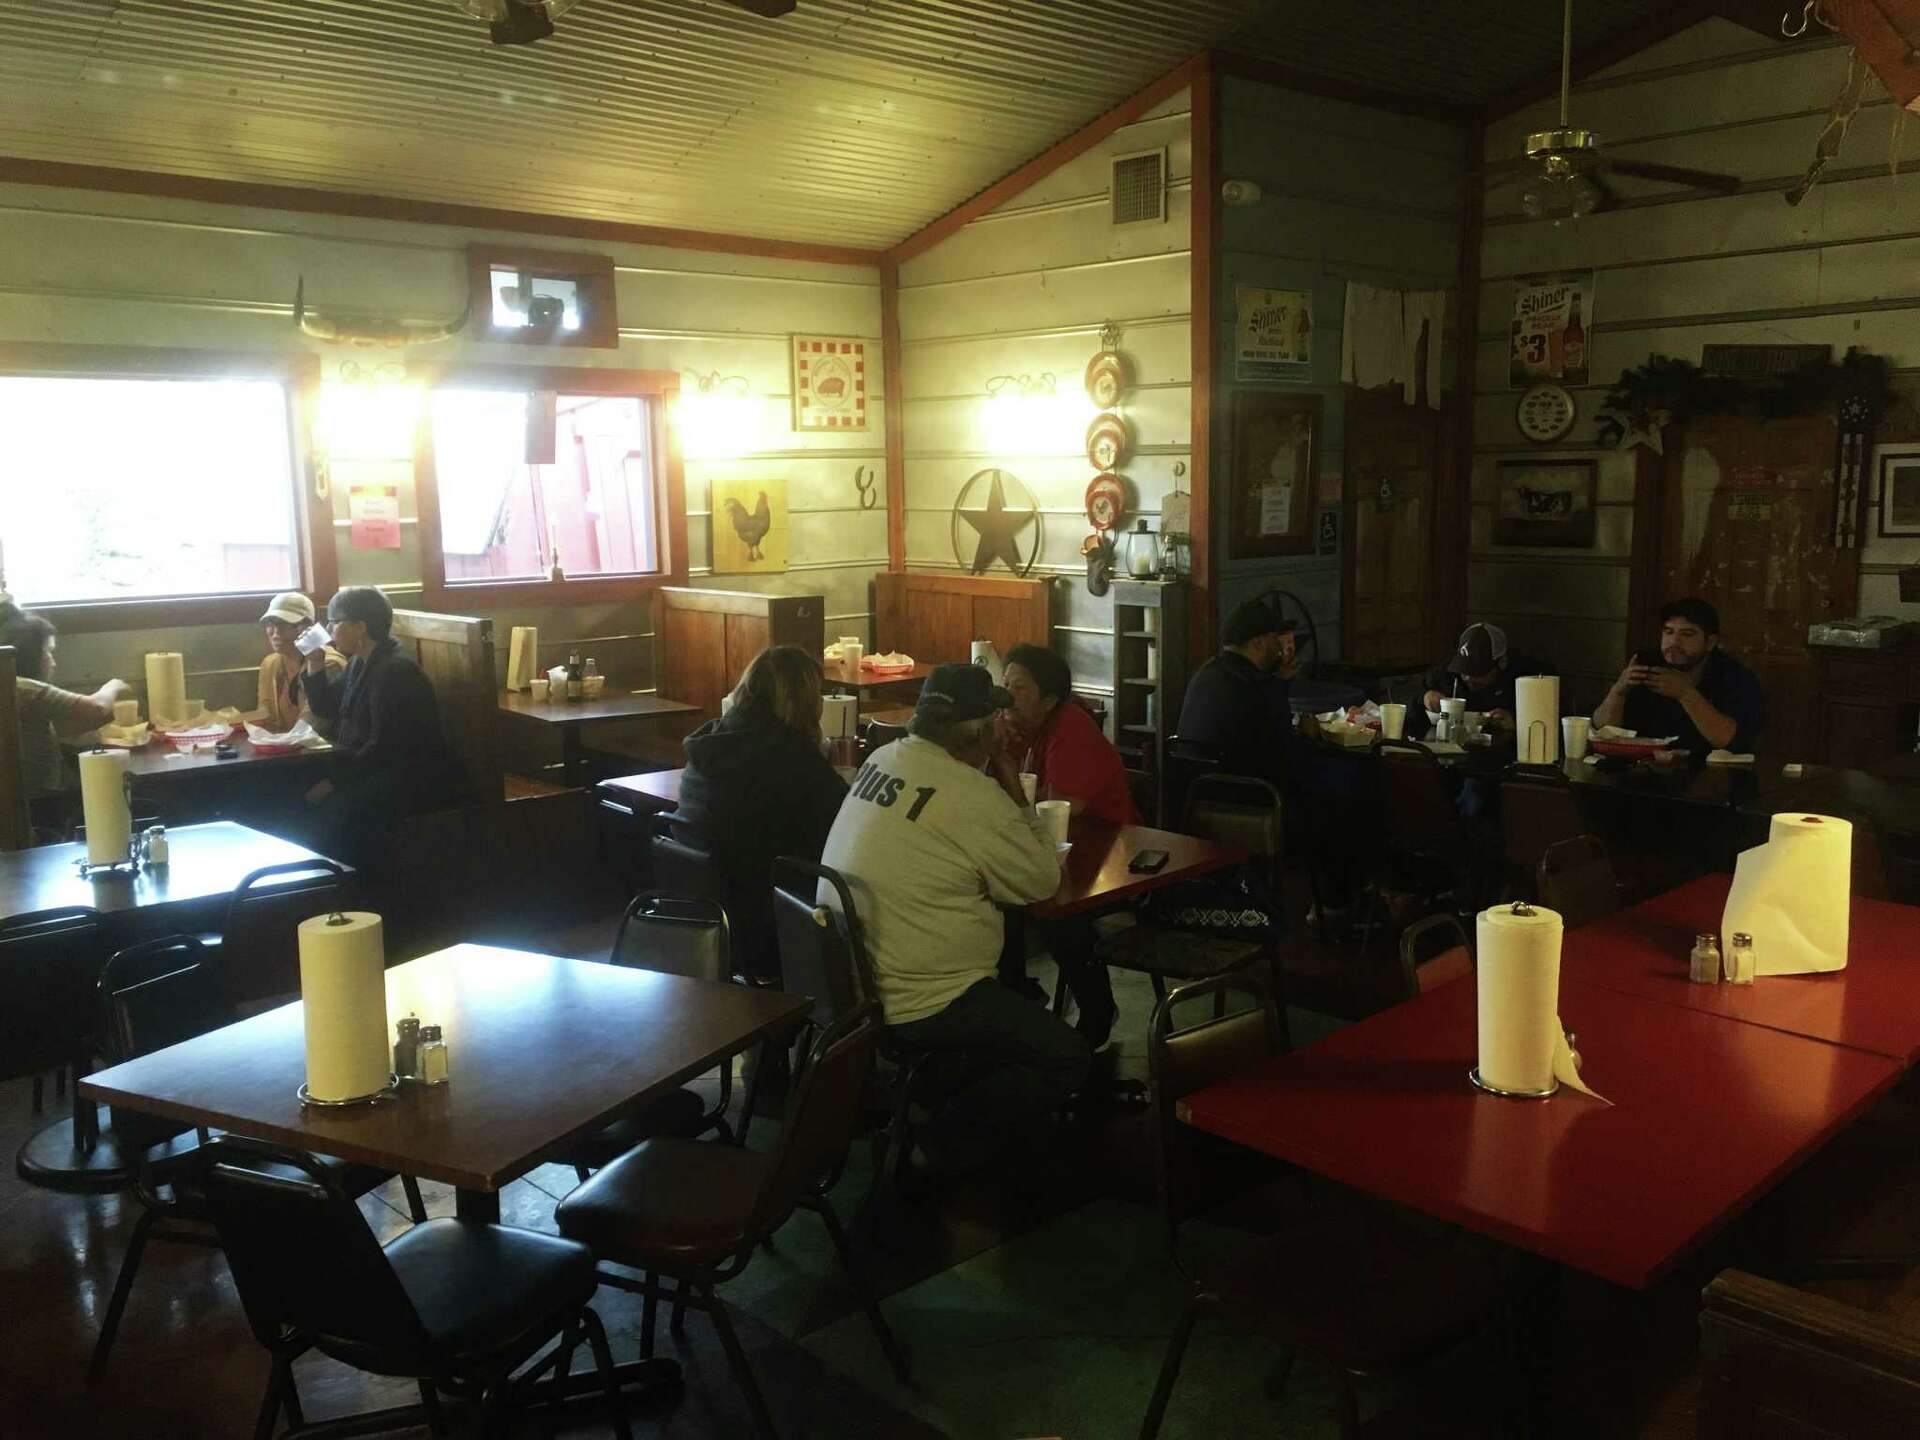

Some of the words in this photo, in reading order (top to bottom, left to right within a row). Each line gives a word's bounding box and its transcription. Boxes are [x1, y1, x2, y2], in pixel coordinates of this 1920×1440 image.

[1520, 287, 1569, 315] Shiner
[1520, 334, 1546, 363] $3
[906, 786, 936, 822] 1
